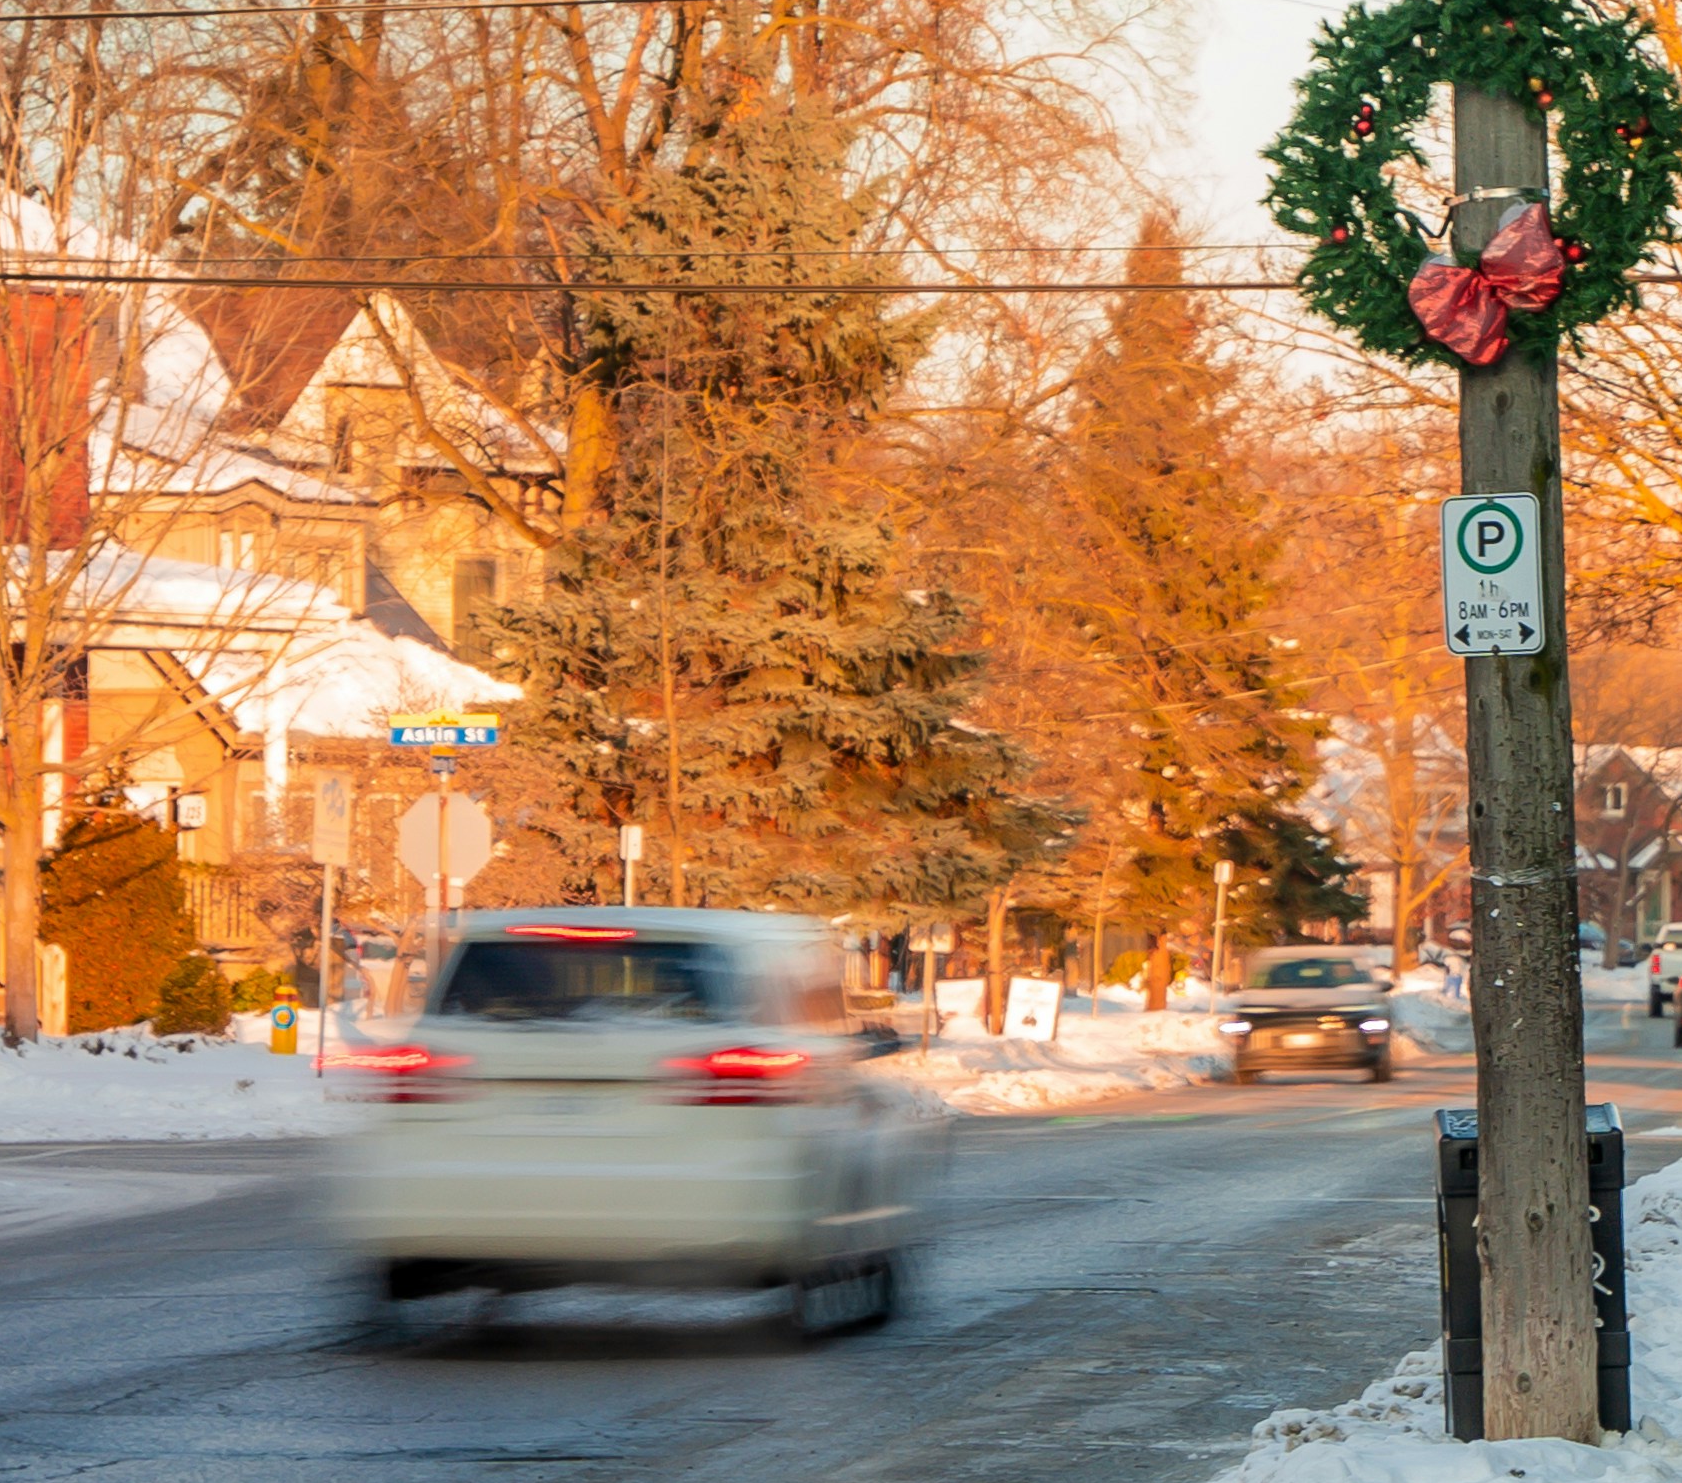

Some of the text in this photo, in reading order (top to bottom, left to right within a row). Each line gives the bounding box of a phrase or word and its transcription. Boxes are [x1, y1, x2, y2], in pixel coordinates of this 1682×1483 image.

[1478, 521, 1505, 557] P
[401, 728, 486, 743] Askin St
